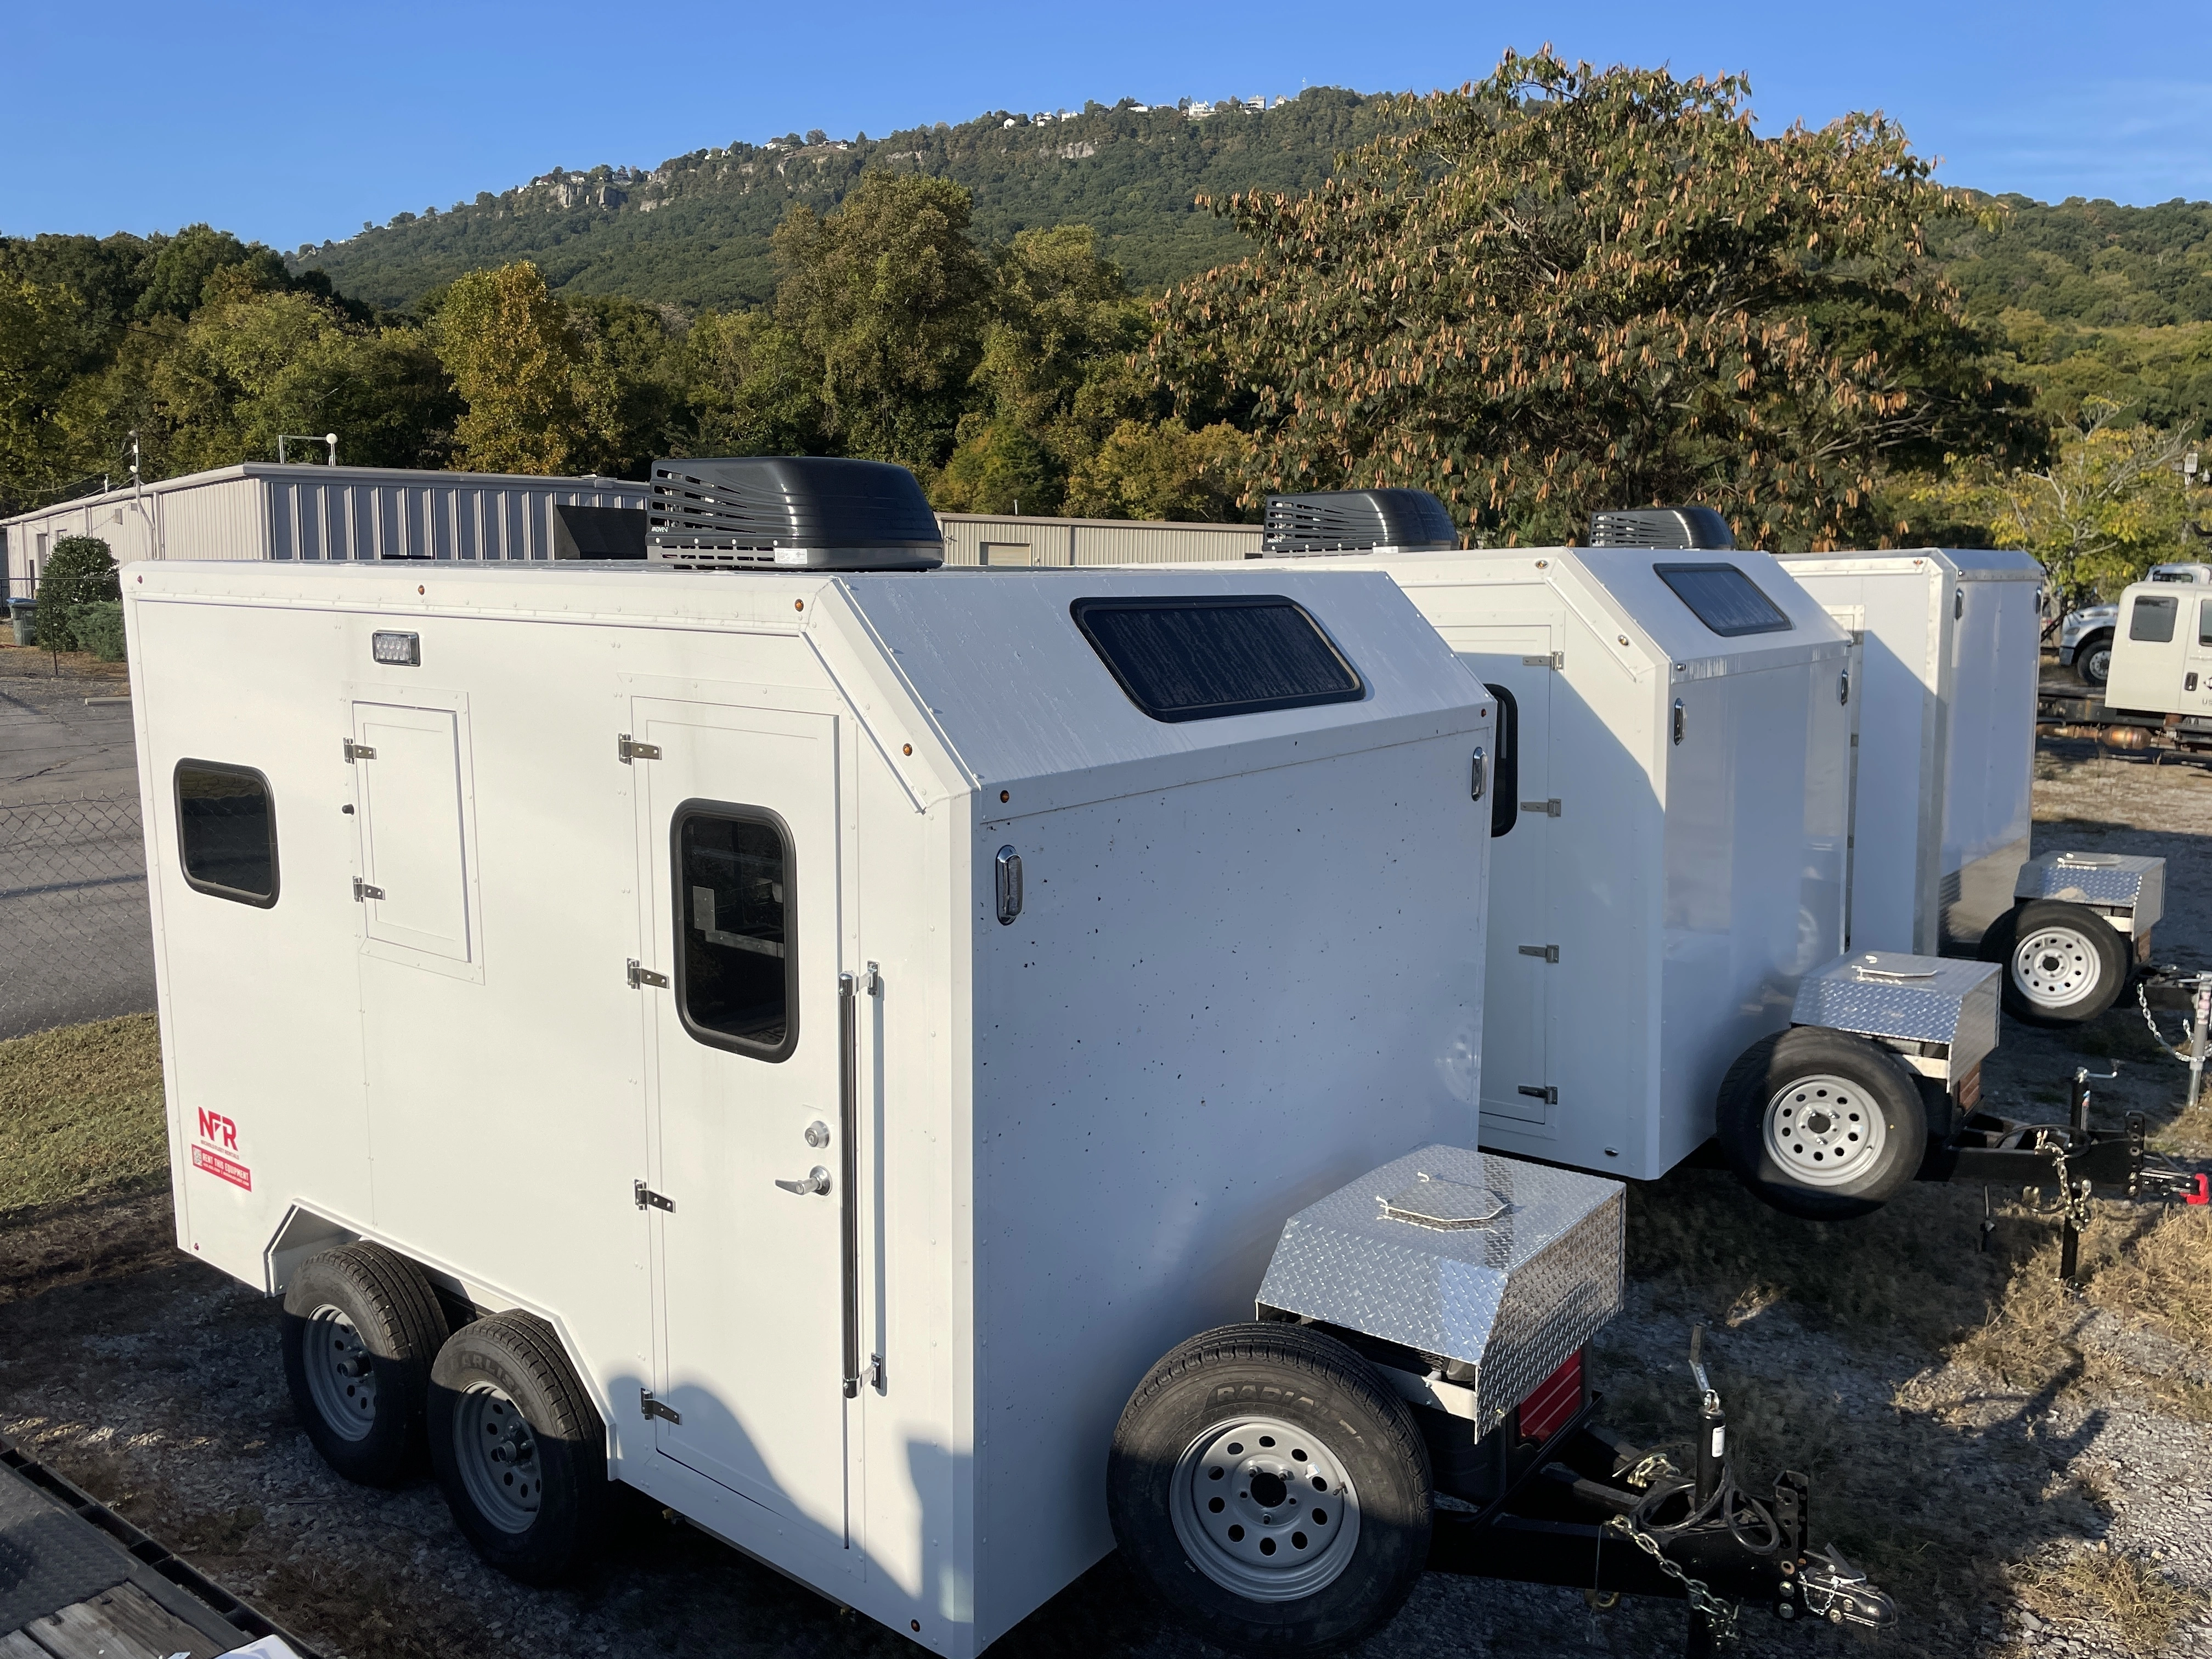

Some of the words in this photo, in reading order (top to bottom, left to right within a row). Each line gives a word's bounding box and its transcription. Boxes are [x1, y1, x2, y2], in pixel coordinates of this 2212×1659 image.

[202, 1152, 213, 1165] RENT
[215, 1158, 224, 1170] THIS
[224, 1163, 249, 1181] EQUIPMENT
